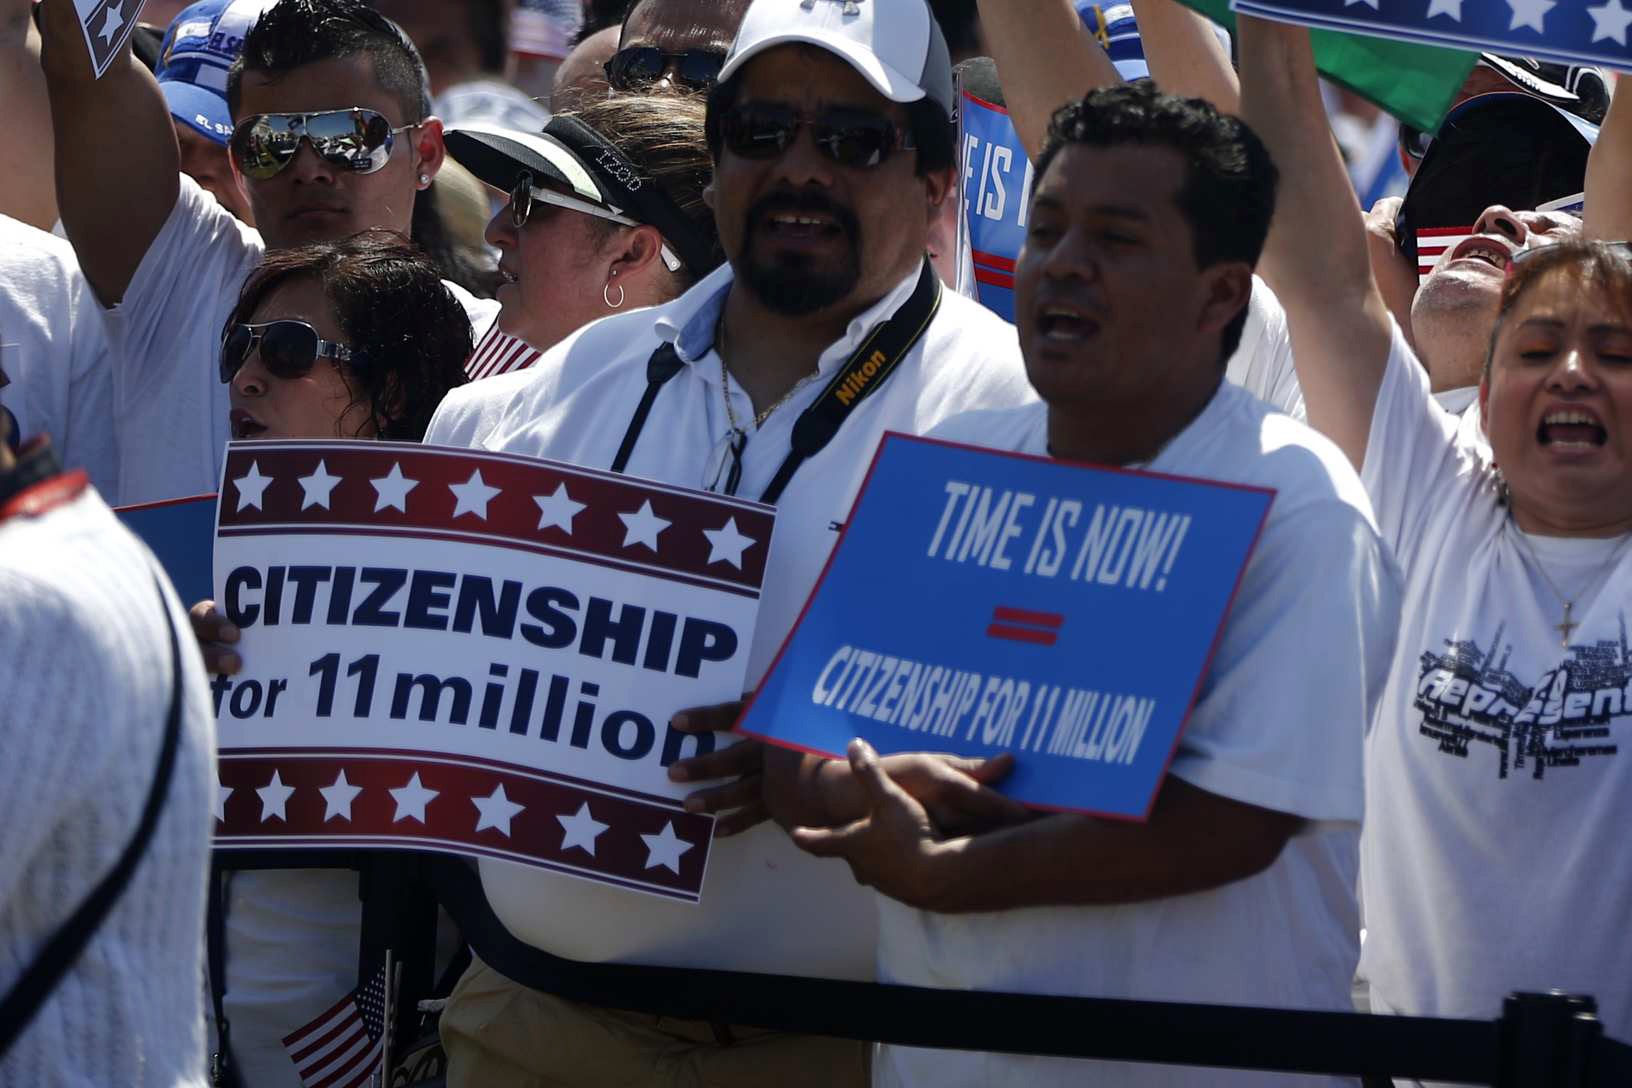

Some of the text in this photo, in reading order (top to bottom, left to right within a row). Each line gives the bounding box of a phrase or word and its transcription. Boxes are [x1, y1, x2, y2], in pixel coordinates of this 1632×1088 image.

[596, 149, 641, 191] IZOD
[976, 142, 1012, 221] IS
[835, 350, 886, 406] Nikon
[928, 481, 1192, 593] TIME IS NOW!
[224, 565, 739, 679] CITIZENSHIP
[211, 652, 717, 769] for 11 million
[812, 644, 1156, 766] CITIZENSHIP FOR 11 MILLION
